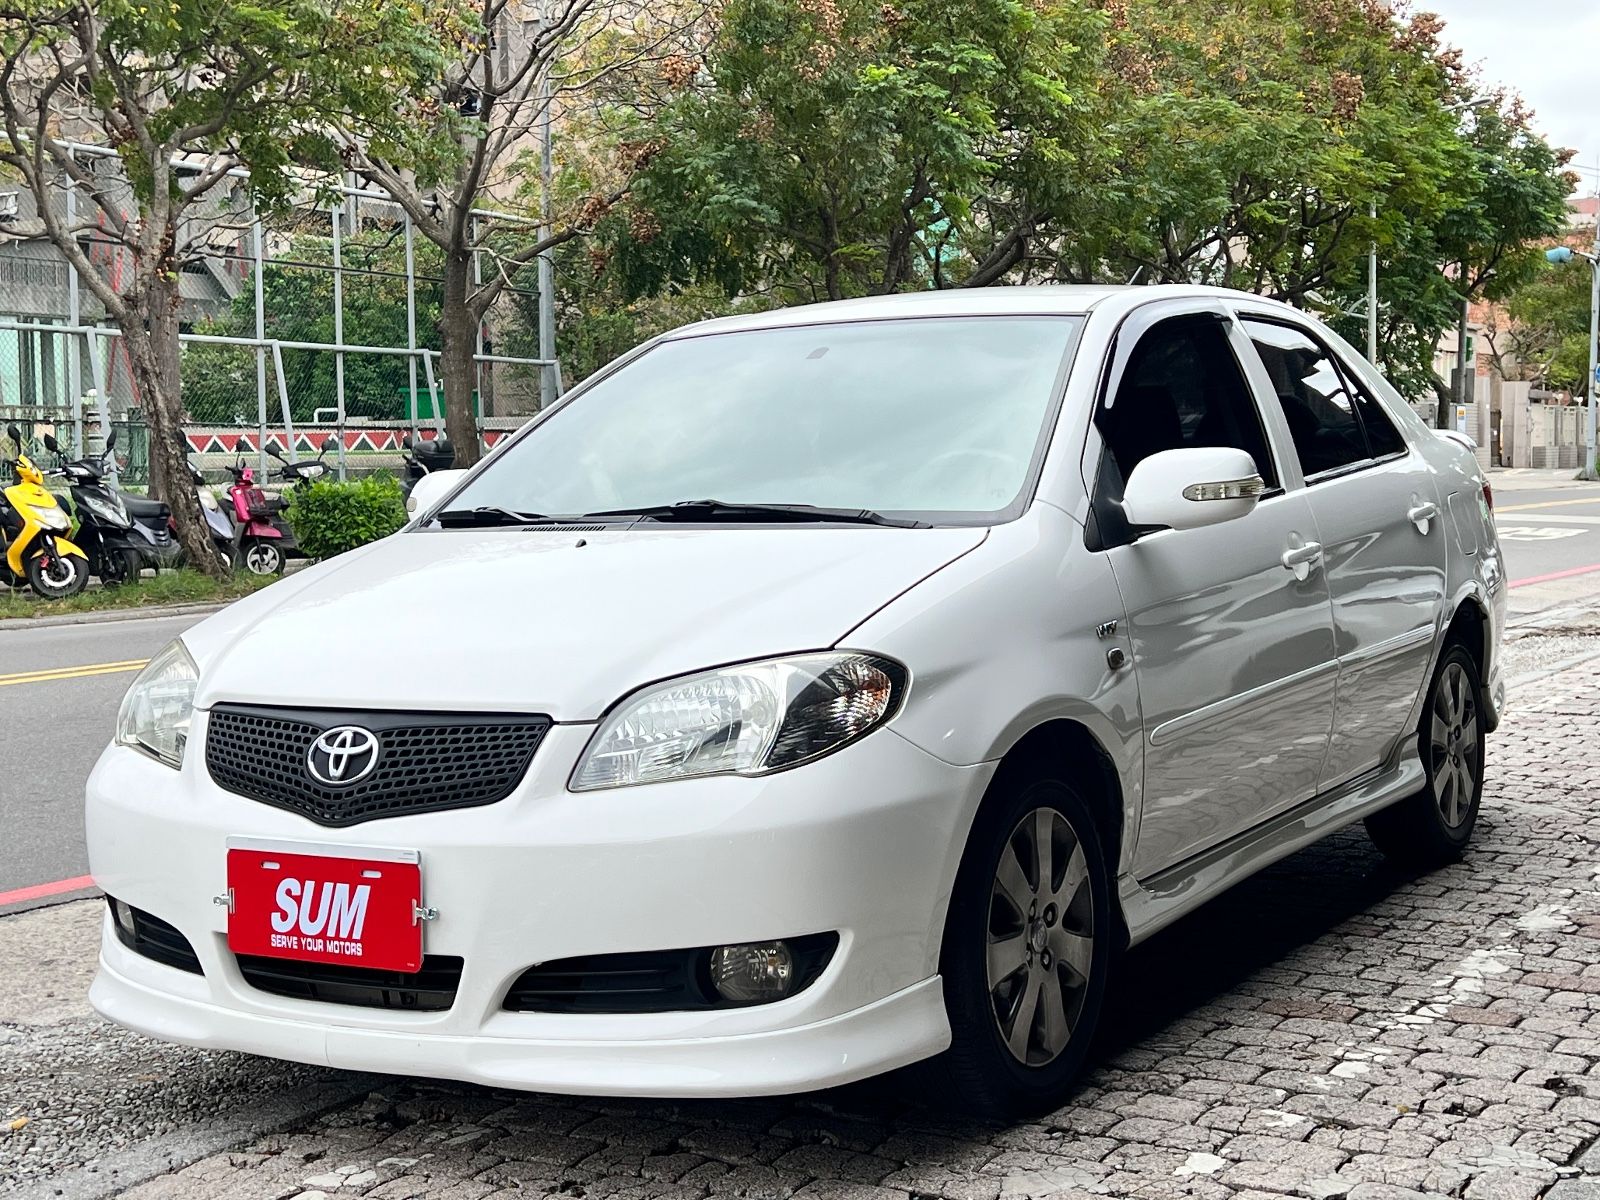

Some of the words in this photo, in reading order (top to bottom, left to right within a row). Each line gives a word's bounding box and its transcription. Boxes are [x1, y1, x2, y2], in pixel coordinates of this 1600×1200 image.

[270, 877, 371, 940] SUM
[270, 934, 298, 949] SERVE
[300, 937, 324, 952] YOUR
[326, 940, 363, 956] MOTORS
